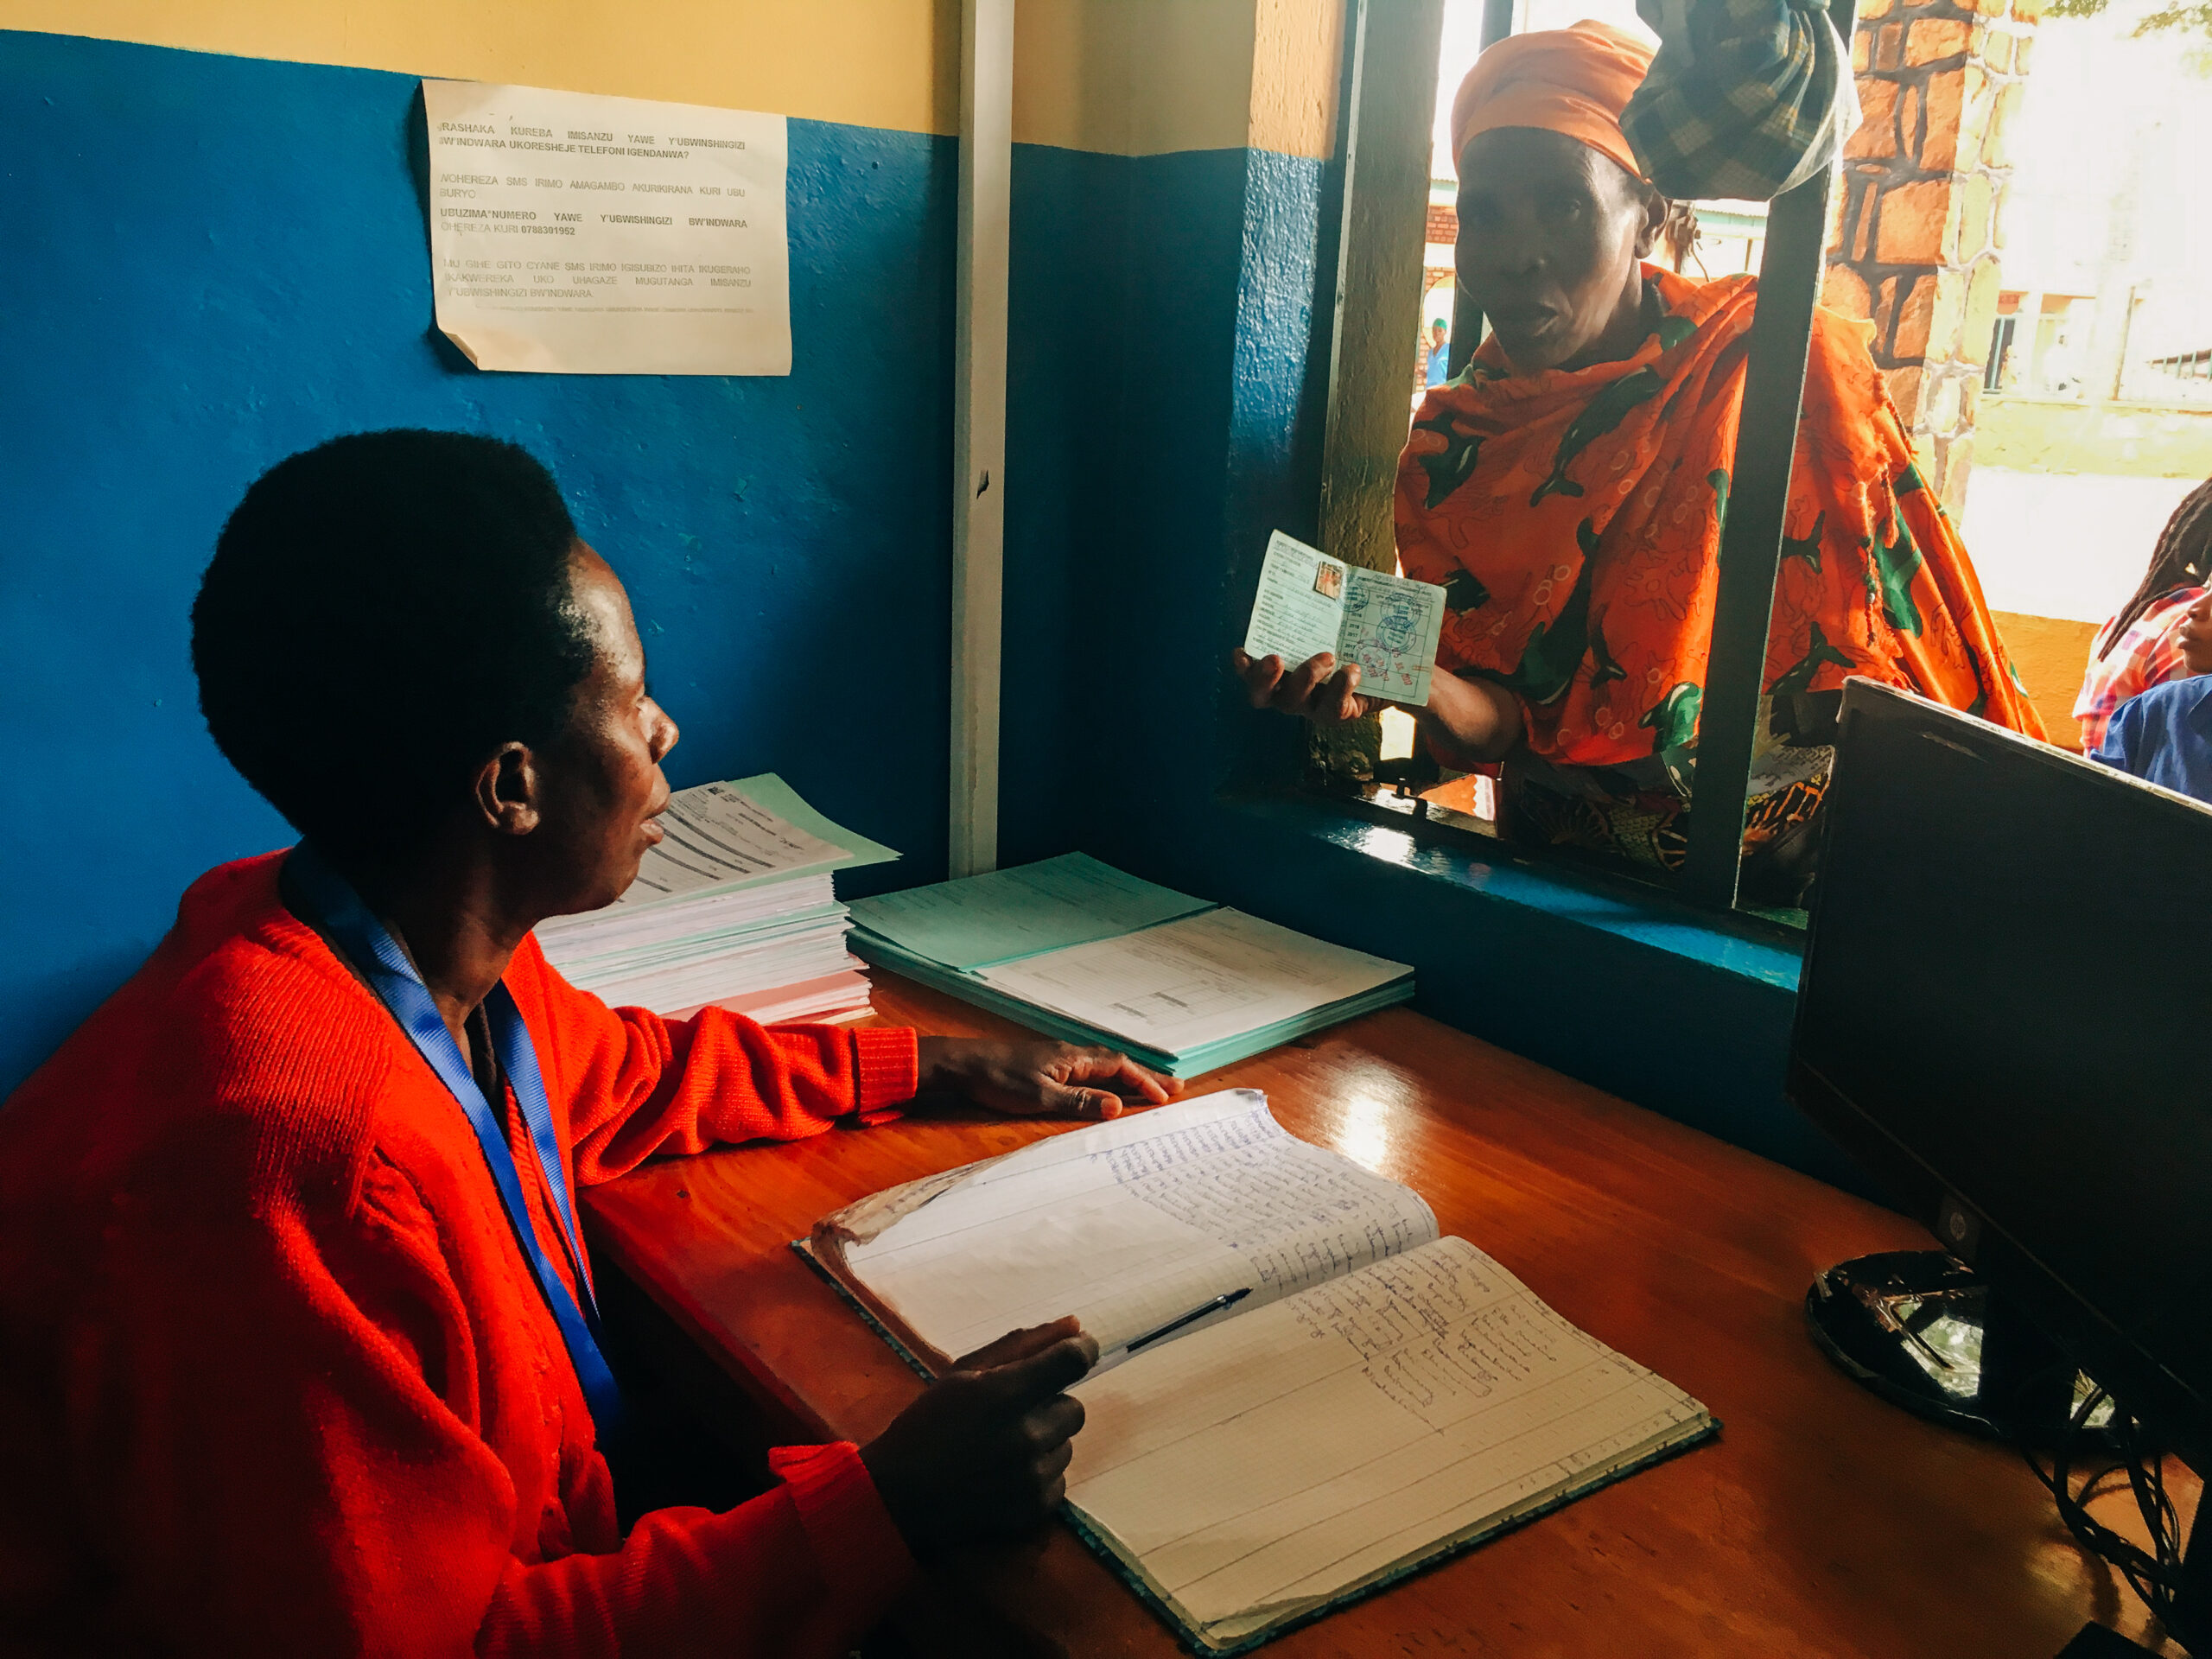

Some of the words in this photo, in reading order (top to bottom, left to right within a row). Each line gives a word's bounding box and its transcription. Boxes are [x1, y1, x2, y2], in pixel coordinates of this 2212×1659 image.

[511, 126, 553, 138] KUREBA
[568, 130, 613, 142] IMISANZU
[627, 134, 655, 144] YAWE
[509, 140, 576, 153] UKORESHEJE
[577, 144, 625, 155] TELEFONI
[626, 149, 690, 159] IGENDANWA?
[439, 188, 476, 199] BURYO
[506, 176, 528, 187] SMS
[535, 178, 563, 188] IRIMO
[569, 180, 626, 191] AMAGAMBO
[632, 182, 694, 194] AKURIKIRANA
[699, 186, 721, 196] KURI
[727, 188, 746, 198] UBU
[553, 213, 583, 222] YAWE
[600, 214, 672, 226] Y'UBWISHINGIZI
[688, 217, 748, 228] BW'INDWARA
[493, 223, 518, 233] KURI
[520, 226, 575, 236] 0788301952
[465, 260, 491, 270] GIHE
[496, 260, 522, 270] GITO
[526, 261, 561, 271] CYANE
[564, 262, 586, 271] SMS
[589, 263, 617, 271] IRIMO
[621, 263, 667, 273] IGISUBIZO
[671, 264, 695, 274] IHITA
[698, 264, 751, 275] IKUGERAHO
[533, 275, 555, 284] UKO
[572, 276, 618, 285] UHAGAZE
[635, 276, 694, 287] MUGUTANGA
[710, 277, 752, 288] IMISANZU
